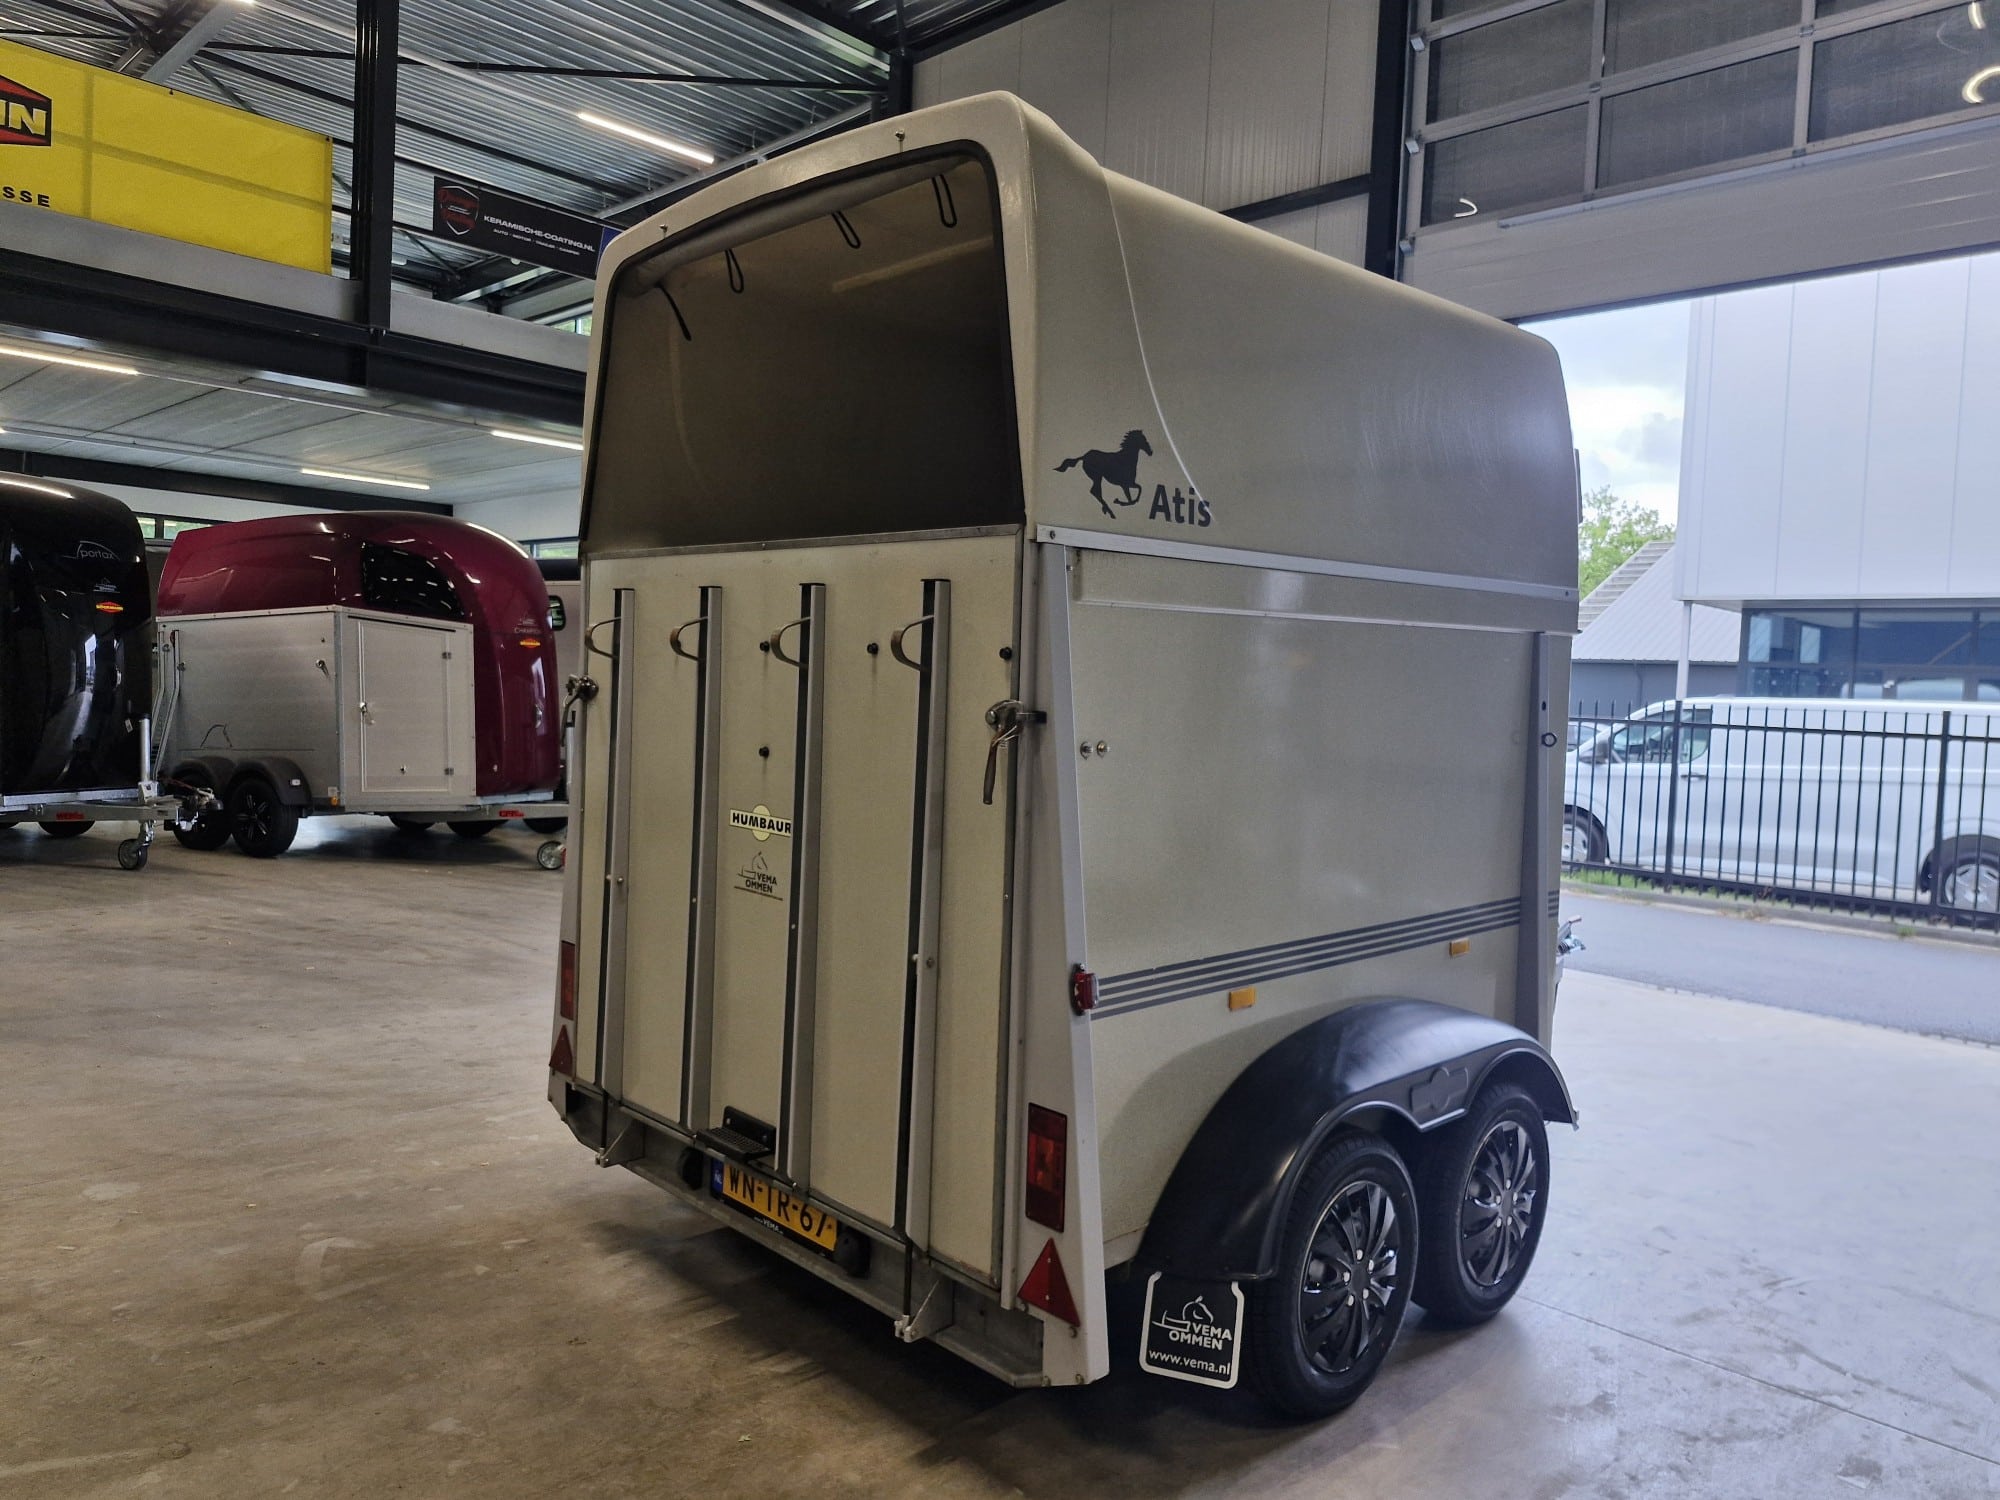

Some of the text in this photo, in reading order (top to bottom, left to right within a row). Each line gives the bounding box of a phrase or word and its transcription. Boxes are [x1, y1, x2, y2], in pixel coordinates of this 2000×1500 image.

[0, 100, 47, 136] N
[1149, 484, 1211, 527] Atis
[732, 812, 792, 834] HUMBAUR
[745, 879, 773, 894] OMMEN
[757, 872, 778, 886] VEMA
[1168, 1330, 1223, 1351] OMMEN
[1192, 1322, 1232, 1341] VEMA
[1149, 1350, 1231, 1376] www.vema.nl
